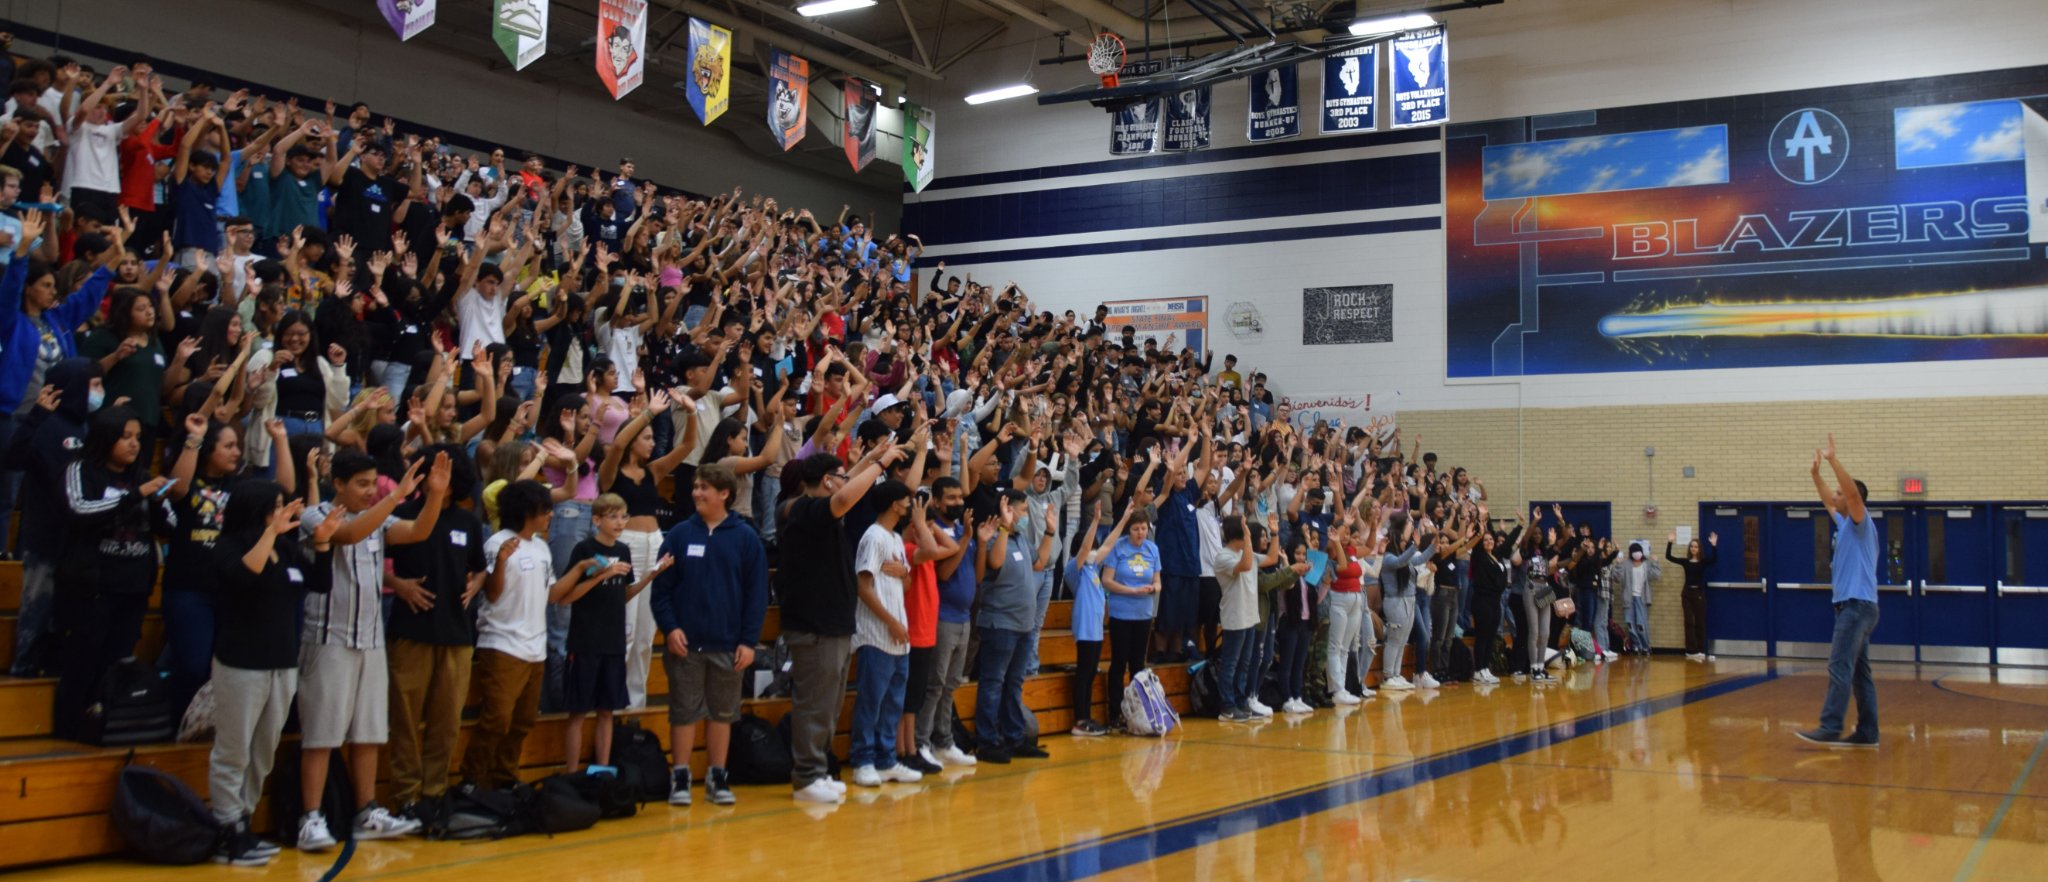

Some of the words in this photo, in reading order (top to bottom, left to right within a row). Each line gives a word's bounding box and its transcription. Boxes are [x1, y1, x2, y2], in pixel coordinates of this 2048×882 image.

[1395, 92, 1410, 101] BOYS
[1410, 87, 1445, 99] VOLLEYBALL
[1326, 99, 1339, 108] BOYS
[1339, 96, 1373, 106] GYMNASTICS
[1401, 101, 1415, 111] 3RD
[1416, 98, 1440, 109] PLACE
[1266, 106, 1298, 118] GYMNASTICS
[1330, 108, 1344, 117] 3RD
[1345, 106, 1368, 116] PLACE
[1411, 109, 1431, 121] 2015
[1171, 119, 1194, 127] CLASS
[1254, 116, 1295, 128] RUNNER-UP
[1338, 117, 1359, 128] 2003
[1169, 124, 1206, 134] FOOTBALL
[1265, 127, 1285, 137] 2002
[1612, 195, 2031, 260] BLAZERS
[1333, 292, 1366, 307] ROCK
[1333, 307, 1380, 320] RESPECT
